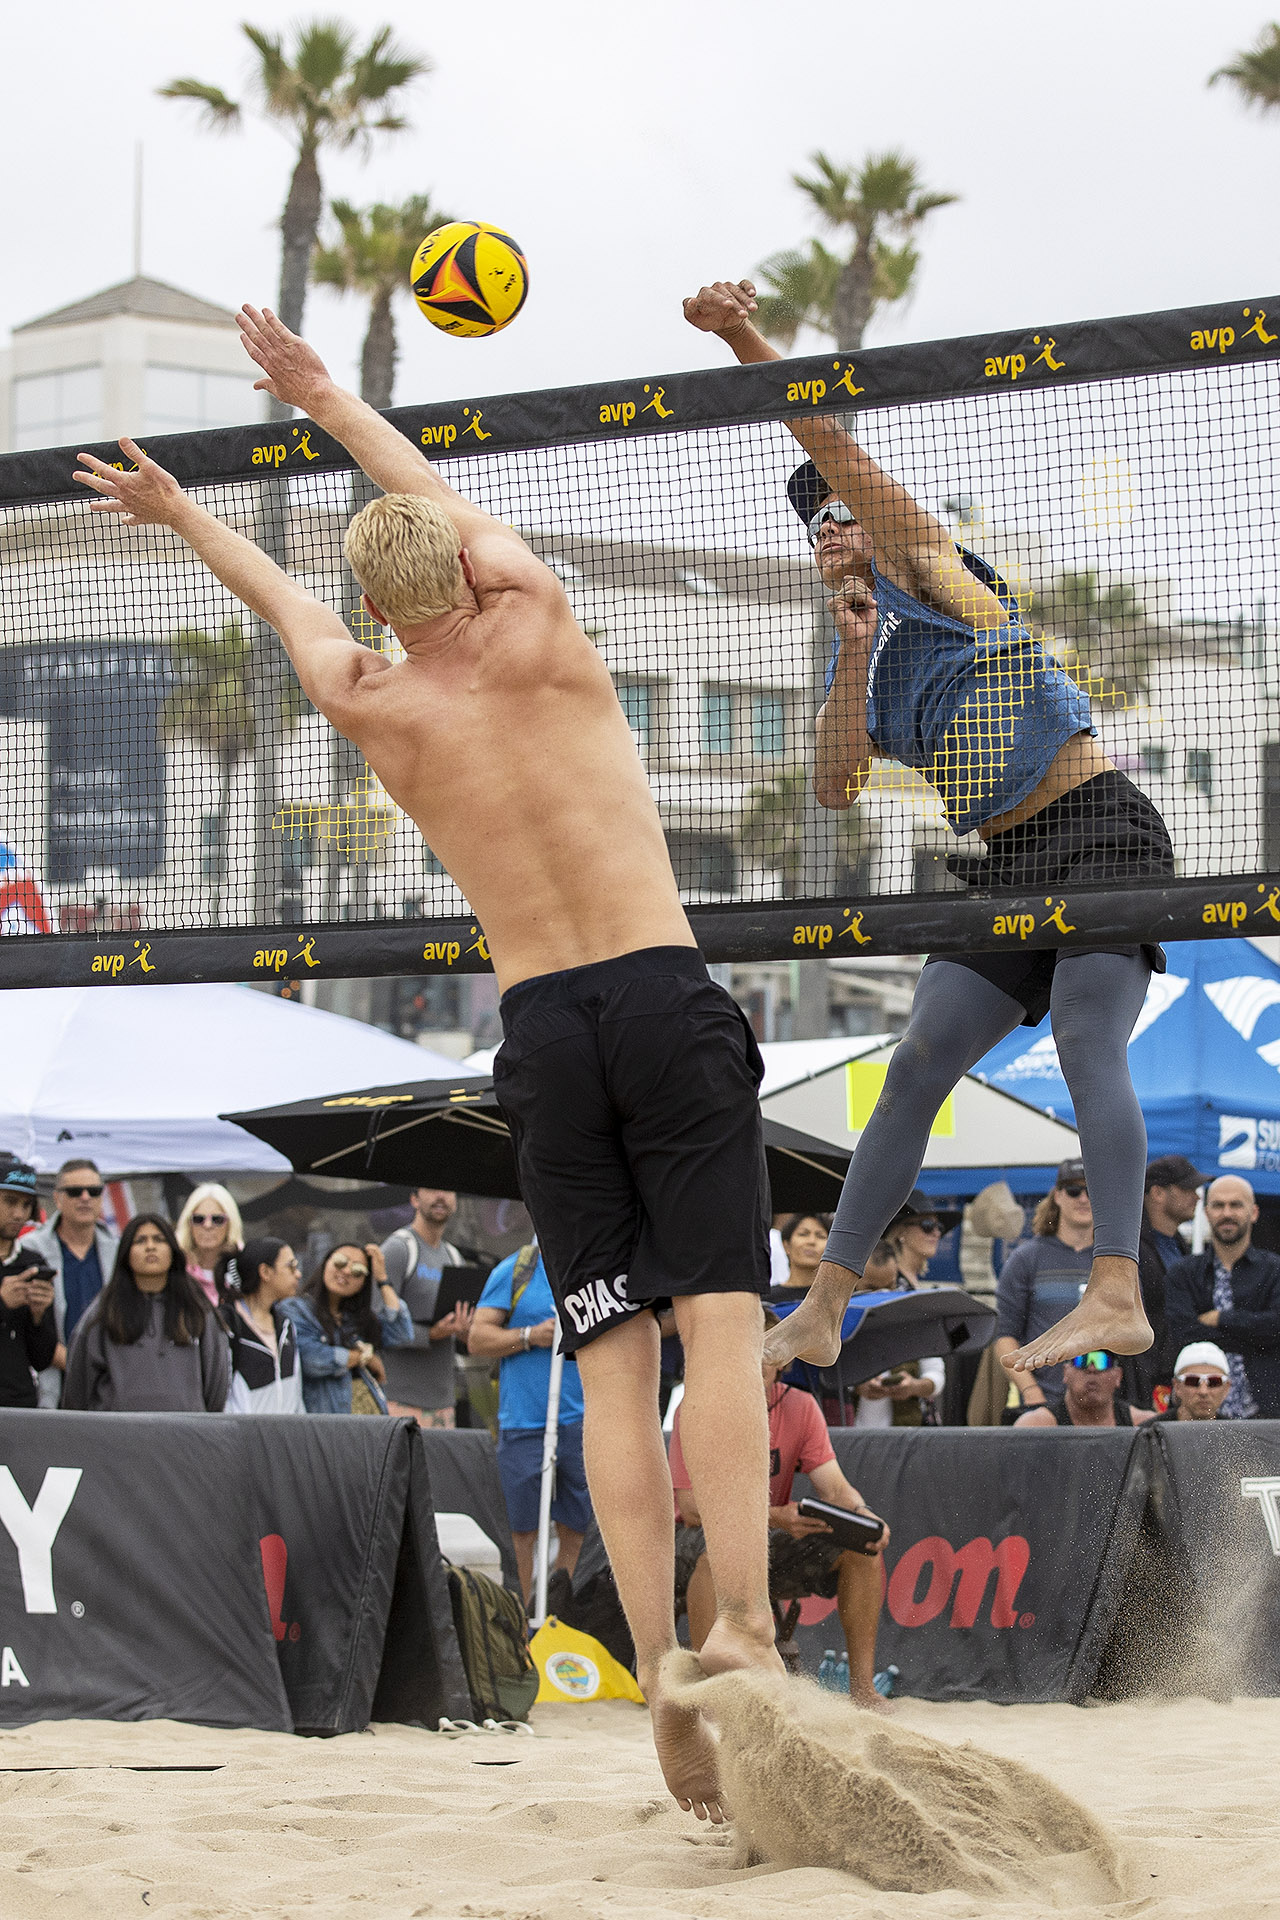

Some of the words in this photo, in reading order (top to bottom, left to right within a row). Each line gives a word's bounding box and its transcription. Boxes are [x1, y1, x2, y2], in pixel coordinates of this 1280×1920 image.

[1190, 327, 1235, 354] avp
[984, 353, 1026, 381] avp
[787, 378, 826, 405] avp
[599, 401, 636, 427] avp
[420, 424, 457, 449] avp
[251, 443, 287, 468] avp
[992, 913, 1035, 941] avp
[1202, 901, 1244, 929] avp
[792, 924, 833, 950] avp
[91, 954, 125, 977] avp
[252, 949, 288, 973] avp
[423, 941, 461, 966] avp
[1, 1646, 30, 1687] A
